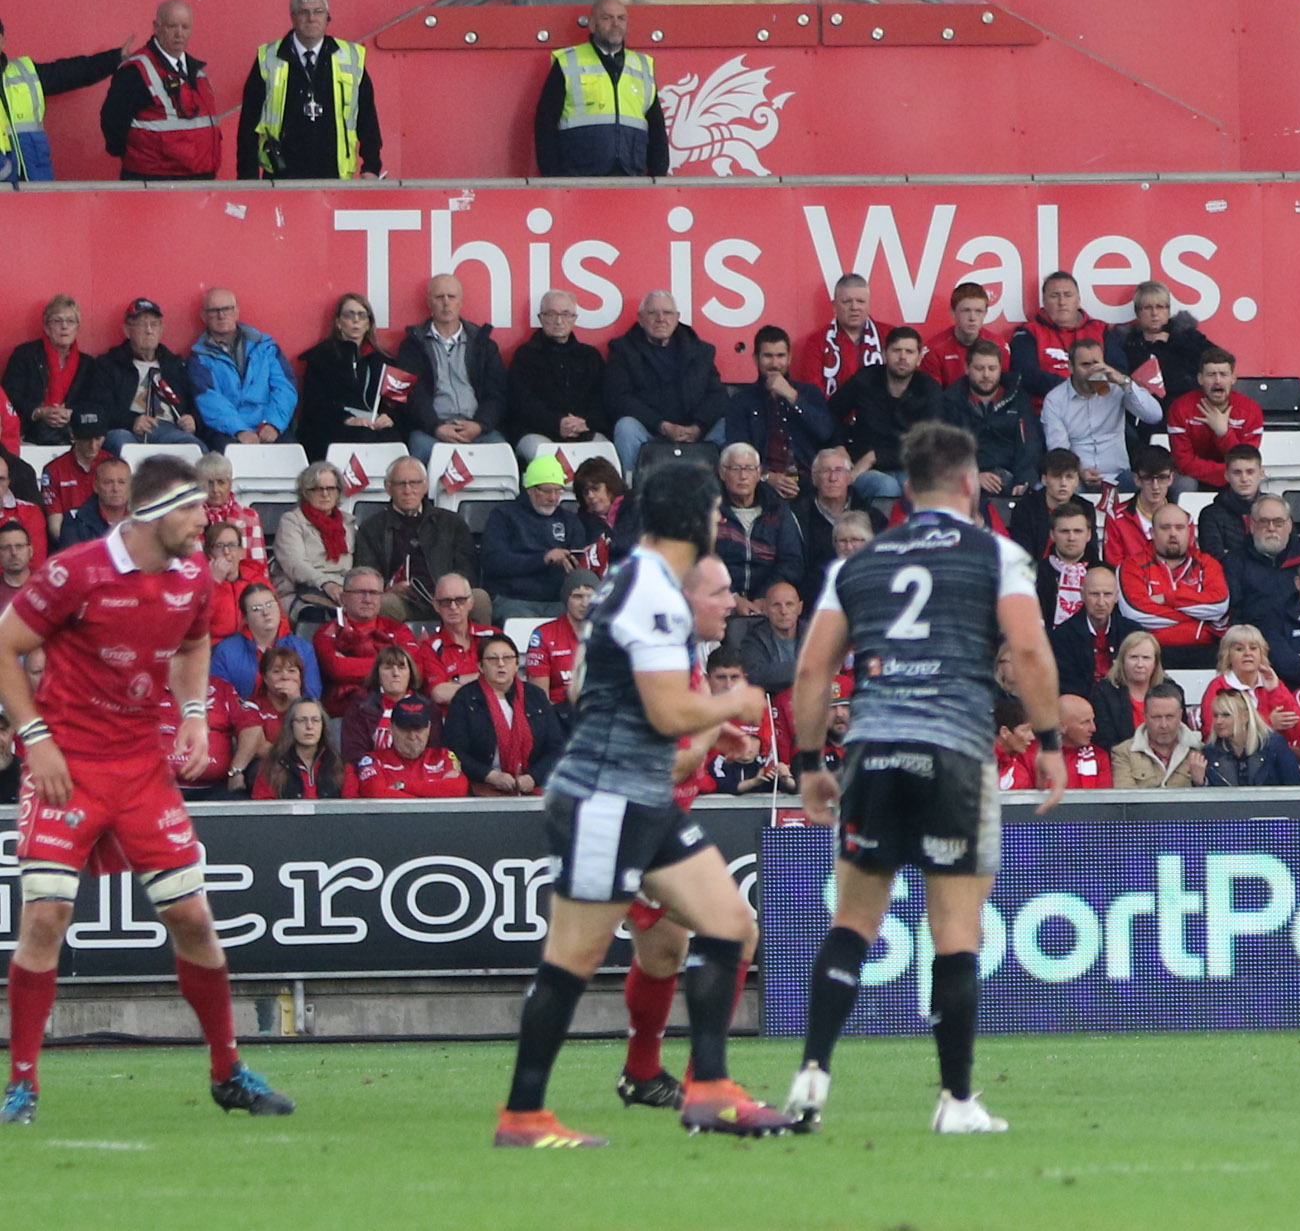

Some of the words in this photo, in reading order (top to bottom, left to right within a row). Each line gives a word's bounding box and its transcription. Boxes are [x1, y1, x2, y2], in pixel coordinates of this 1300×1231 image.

[333, 208, 625, 329] This
[667, 206, 766, 329] is
[803, 203, 1259, 324] Wales.
[885, 565, 935, 640] 2
